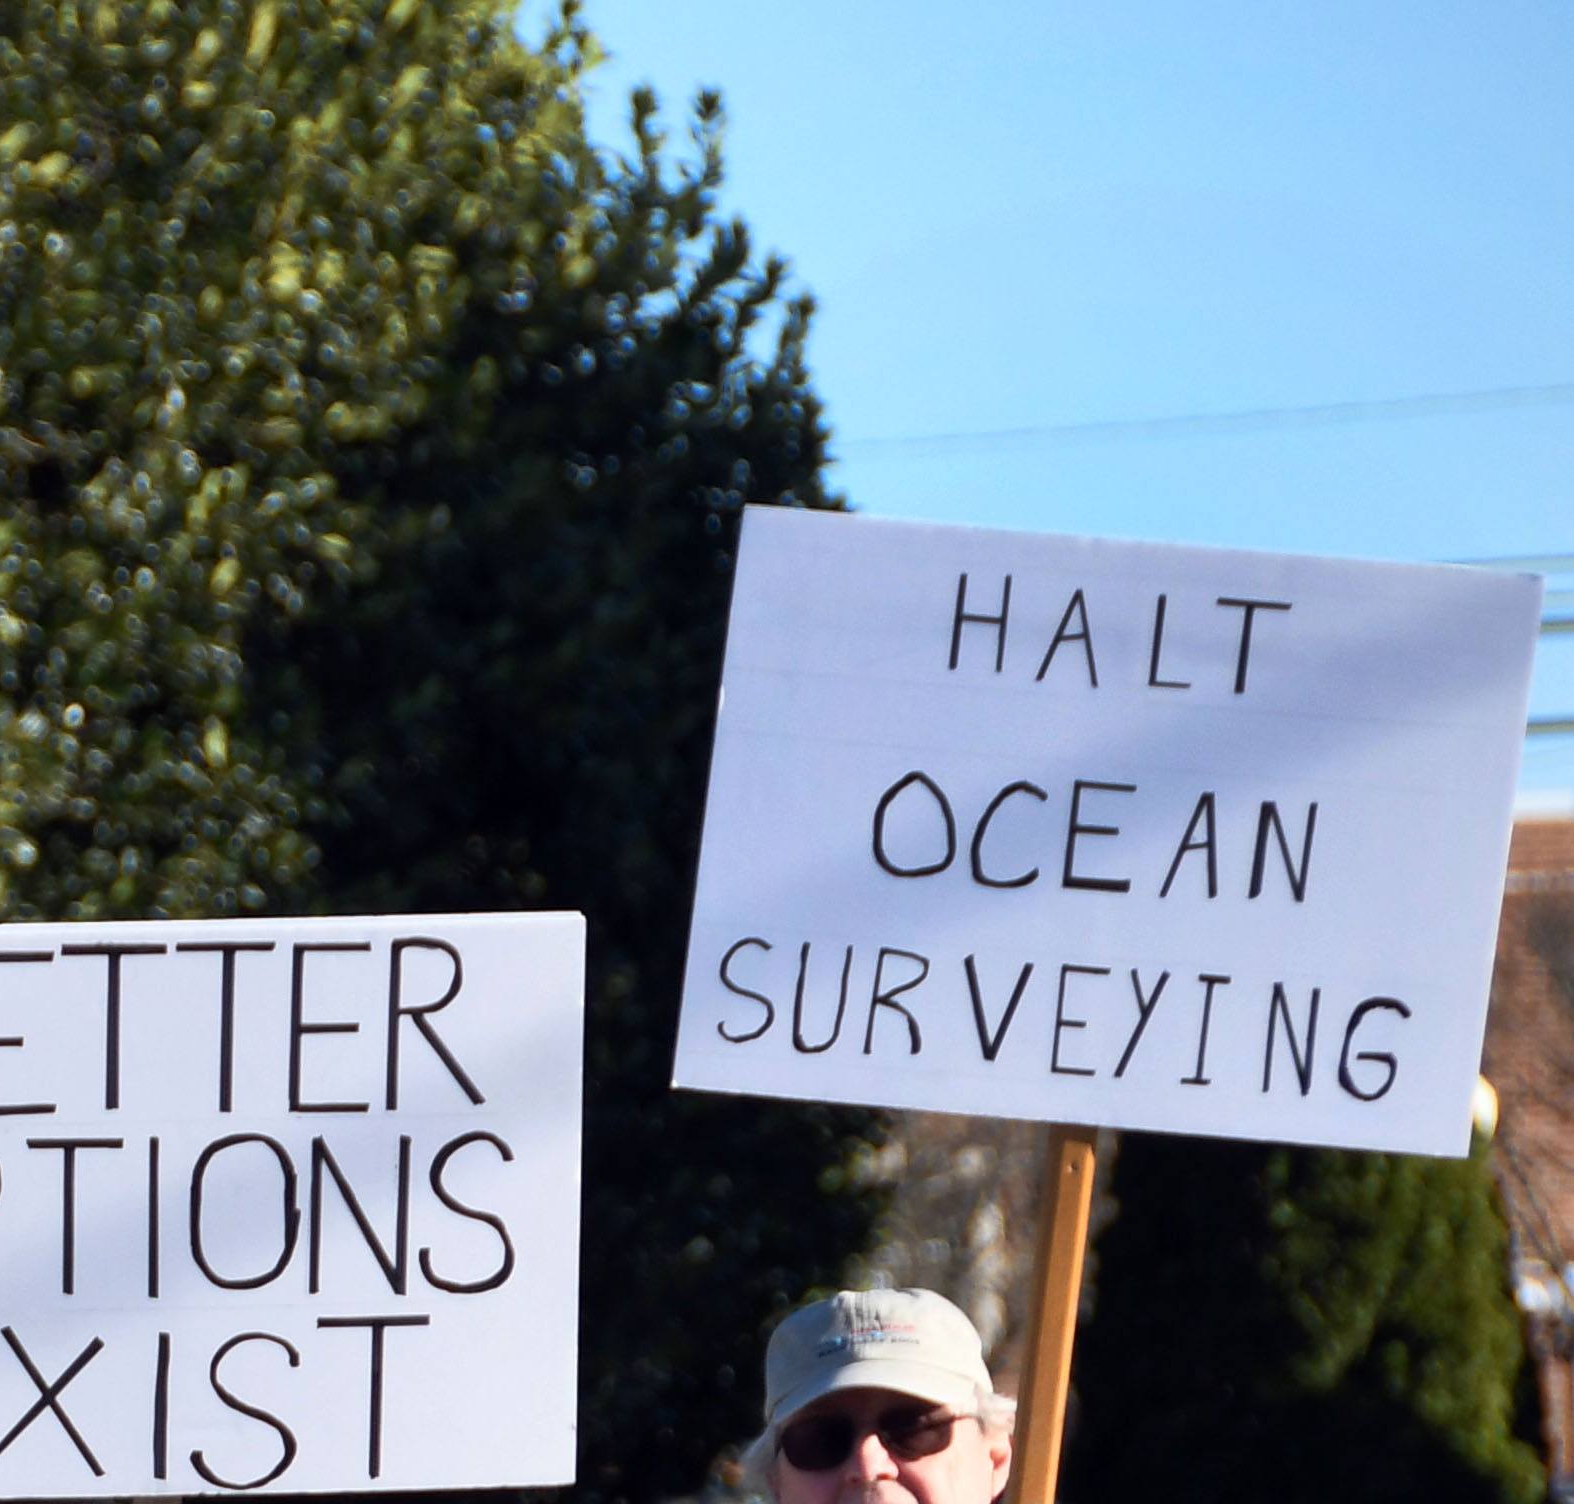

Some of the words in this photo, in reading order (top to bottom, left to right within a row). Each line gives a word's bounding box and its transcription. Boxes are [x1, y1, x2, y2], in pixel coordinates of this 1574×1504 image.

[948, 573, 1292, 695] HALT
[872, 770, 1319, 903] OCEAN
[716, 936, 1413, 1102] SURVEYING
